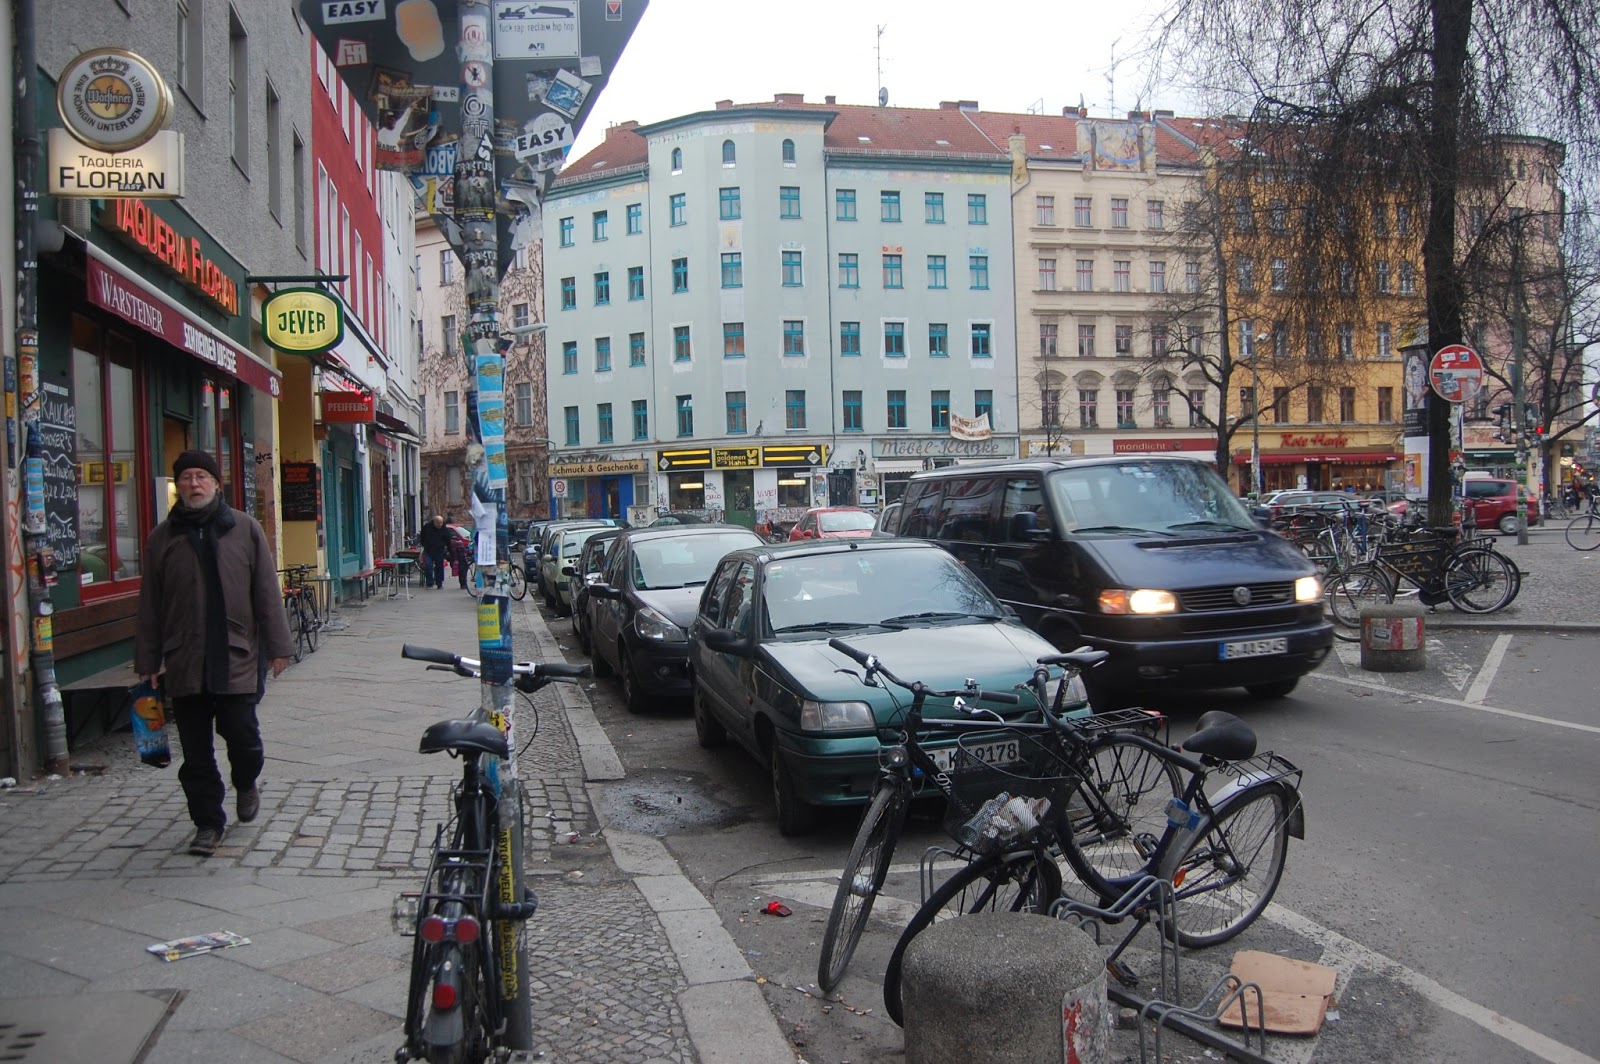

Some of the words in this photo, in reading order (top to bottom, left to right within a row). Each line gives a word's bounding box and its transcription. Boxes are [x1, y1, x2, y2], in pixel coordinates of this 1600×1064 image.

[328, 1, 379, 18] EASY
[552, 22, 562, 32] hip
[563, 22, 575, 32] hop
[74, 74, 90, 93] EINE
[129, 75, 145, 107] BIEREN
[73, 94, 96, 127] KÖNIGIN
[127, 107, 143, 125] DEN
[97, 120, 128, 131] UNTER
[517, 127, 566, 152] EASY
[78, 155, 144, 169] TAQUERIA
[455, 160, 493, 173] FRAKTUS
[59, 166, 165, 190] FLORIAN
[115, 197, 189, 279] TAQUERIA
[191, 236, 238, 316] FLORIAN
[464, 250, 498, 262] FRAKTU
[100, 270, 165, 335] WARSTEINER
[278, 310, 326, 335] JEVER
[466, 322, 499, 335] RAKTUS
[41, 390, 76, 428] RAUCHER
[327, 402, 369, 412] PFEIFFERS
[1116, 442, 1167, 451] mondlicht
[597, 462, 639, 472] Geschenke
[976, 742, 1017, 763] 9178
